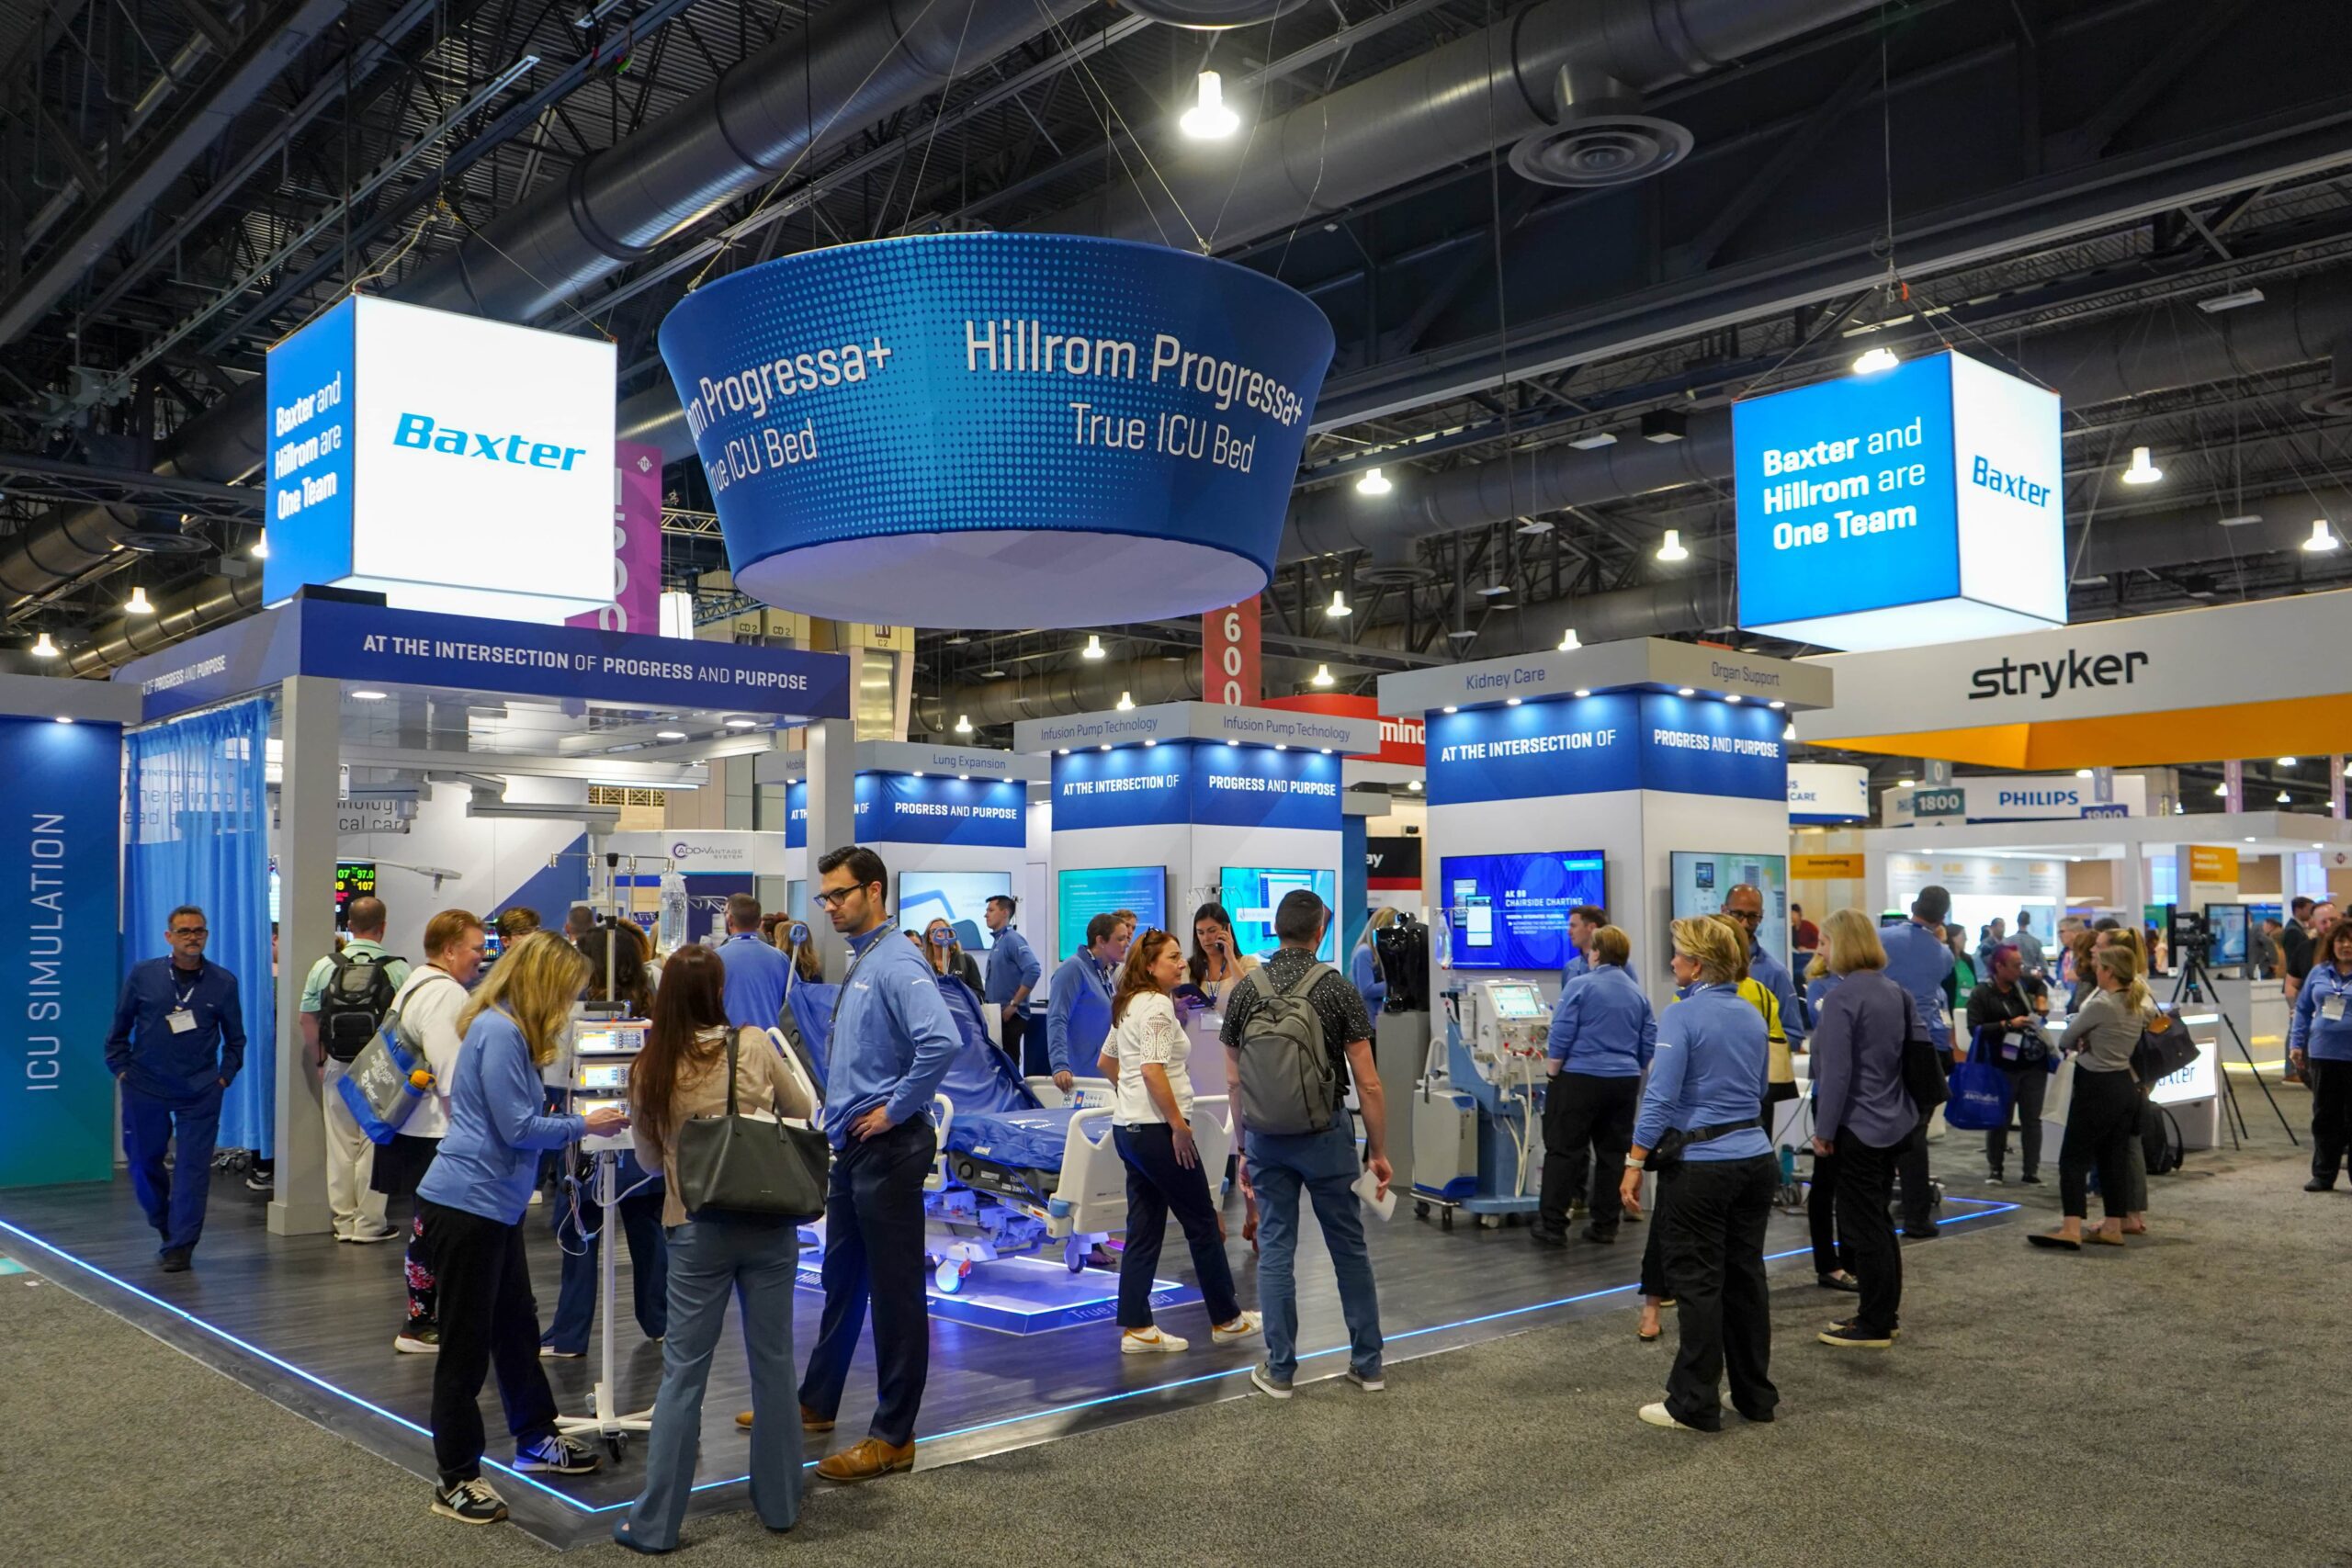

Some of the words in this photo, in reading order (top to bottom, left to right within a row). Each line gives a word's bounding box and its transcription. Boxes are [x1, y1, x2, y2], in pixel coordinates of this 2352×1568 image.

[699, 336, 893, 423] Progressa+
[966, 319, 1137, 380] Hillrom
[1151, 333, 1303, 426] Progressa+
[276, 393, 315, 437] Baxter
[317, 370, 341, 412] and
[392, 412, 586, 471] Baxter
[1069, 401, 1145, 450] True
[1158, 412, 1206, 458] ICU
[1213, 424, 1256, 473] Bed
[1763, 435, 1860, 478] Baxter
[1867, 416, 1923, 454] and
[275, 436, 318, 480] Hillrom
[320, 424, 341, 456] are
[705, 457, 729, 497] True
[725, 434, 762, 481] ICU
[763, 417, 818, 468] Bed
[277, 490, 300, 520] One
[301, 471, 337, 508] Team
[1763, 475, 1869, 514] Hillrom
[1877, 462, 1926, 493] are
[1973, 455, 2051, 508] Baxter
[1773, 519, 1828, 550] One
[1834, 504, 1917, 540] Team
[752, 625, 758, 634] 2
[786, 627, 791, 636] 2
[197, 655, 226, 678] PURPOSE
[364, 634, 389, 651] AT
[392, 637, 430, 657] THE
[435, 640, 569, 669] INTERSECTION
[575, 654, 596, 671] OF
[604, 657, 693, 681] PROGRESS
[698, 666, 729, 683] AND
[735, 670, 808, 691] PURPOSE
[1224, 603, 1241, 706] 600
[1466, 670, 1510, 691] Kidney
[1514, 667, 1545, 684] Care
[1712, 660, 1741, 685] Organ
[1743, 667, 1781, 688] Support
[1968, 648, 2148, 700] stryker
[1041, 725, 1075, 741] Infusion
[1077, 723, 1102, 740] Pump
[1104, 716, 1159, 736] Technology
[1223, 716, 1263, 732] Infusion
[1266, 719, 1295, 738] Pump
[1296, 722, 1351, 743] Technology
[1441, 746, 1458, 762] AT
[1460, 744, 1486, 761] THE
[1489, 732, 1592, 757] INTERSECTION
[1597, 729, 1617, 746] OF
[1654, 728, 1709, 750] PROGRESS
[1712, 736, 1732, 753] AND
[1735, 739, 1779, 759] PURPOSE
[933, 753, 956, 769] Lung
[959, 756, 1006, 770] Expansion
[1063, 784, 1074, 795] AT
[1076, 782, 1093, 795] THE
[1095, 776, 1164, 794] INTERSECTION
[1166, 774, 1180, 787] OF
[1209, 775, 1265, 792] PROGRESS
[1267, 779, 1288, 793] AND
[1290, 781, 1336, 796] PURPOSE
[1790, 793, 1816, 801] CARE
[1999, 791, 2079, 806] PHILIPS
[791, 809, 798, 820] AT
[860, 803, 870, 814] OF
[895, 802, 948, 816] PROGRESS
[950, 805, 970, 818] AND
[972, 807, 1017, 819] PURPOSE
[1918, 795, 1960, 811] 1800
[357, 870, 374, 879] 97.0
[357, 881, 374, 891] 107
[28, 813, 64, 1021] SIMULATION
[1505, 898, 1544, 908] CHAIRSIDE
[1545, 897, 1583, 906] CHARTING
[27, 1035, 61, 1091] ICU
